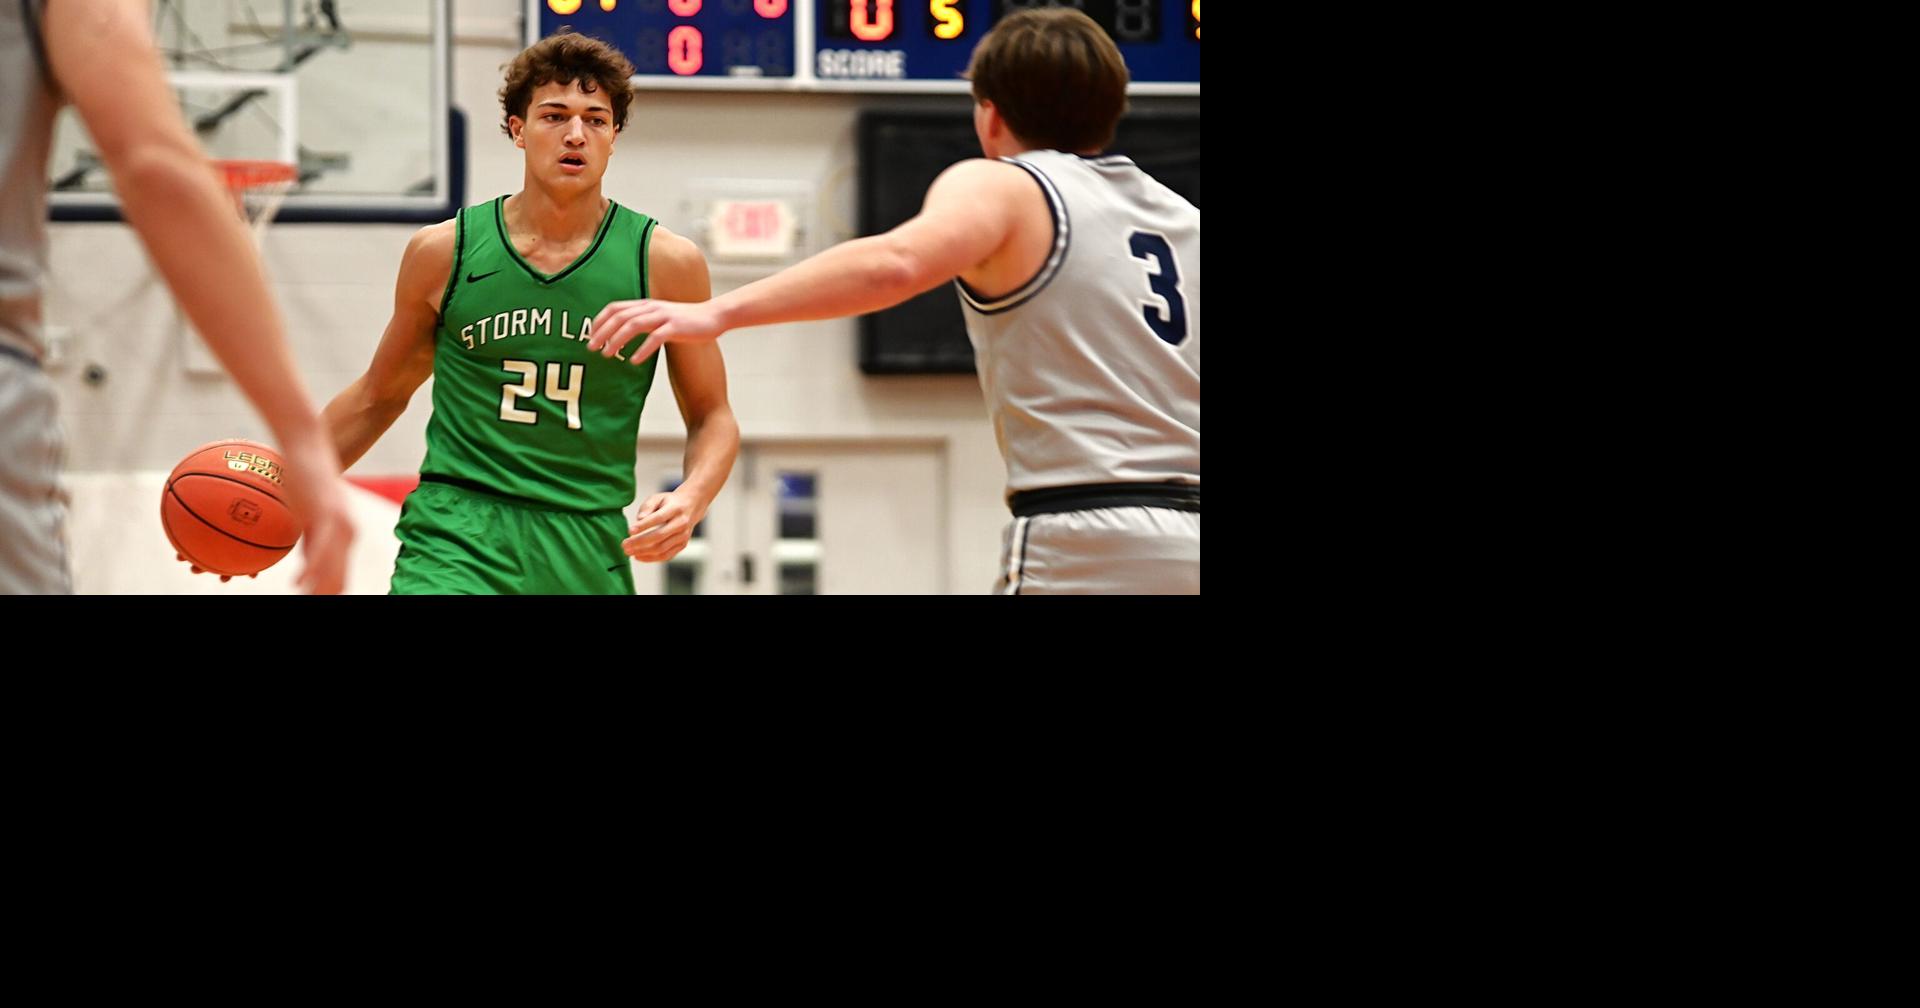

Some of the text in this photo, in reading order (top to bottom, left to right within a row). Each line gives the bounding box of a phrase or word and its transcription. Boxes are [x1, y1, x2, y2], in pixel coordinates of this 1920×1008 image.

[668, 25, 703, 75] 0
[818, 49, 905, 78] SCORE
[1126, 228, 1189, 346] 3
[460, 307, 626, 362] STORM LA
[499, 359, 584, 430] 24
[223, 450, 284, 476] LEGA
